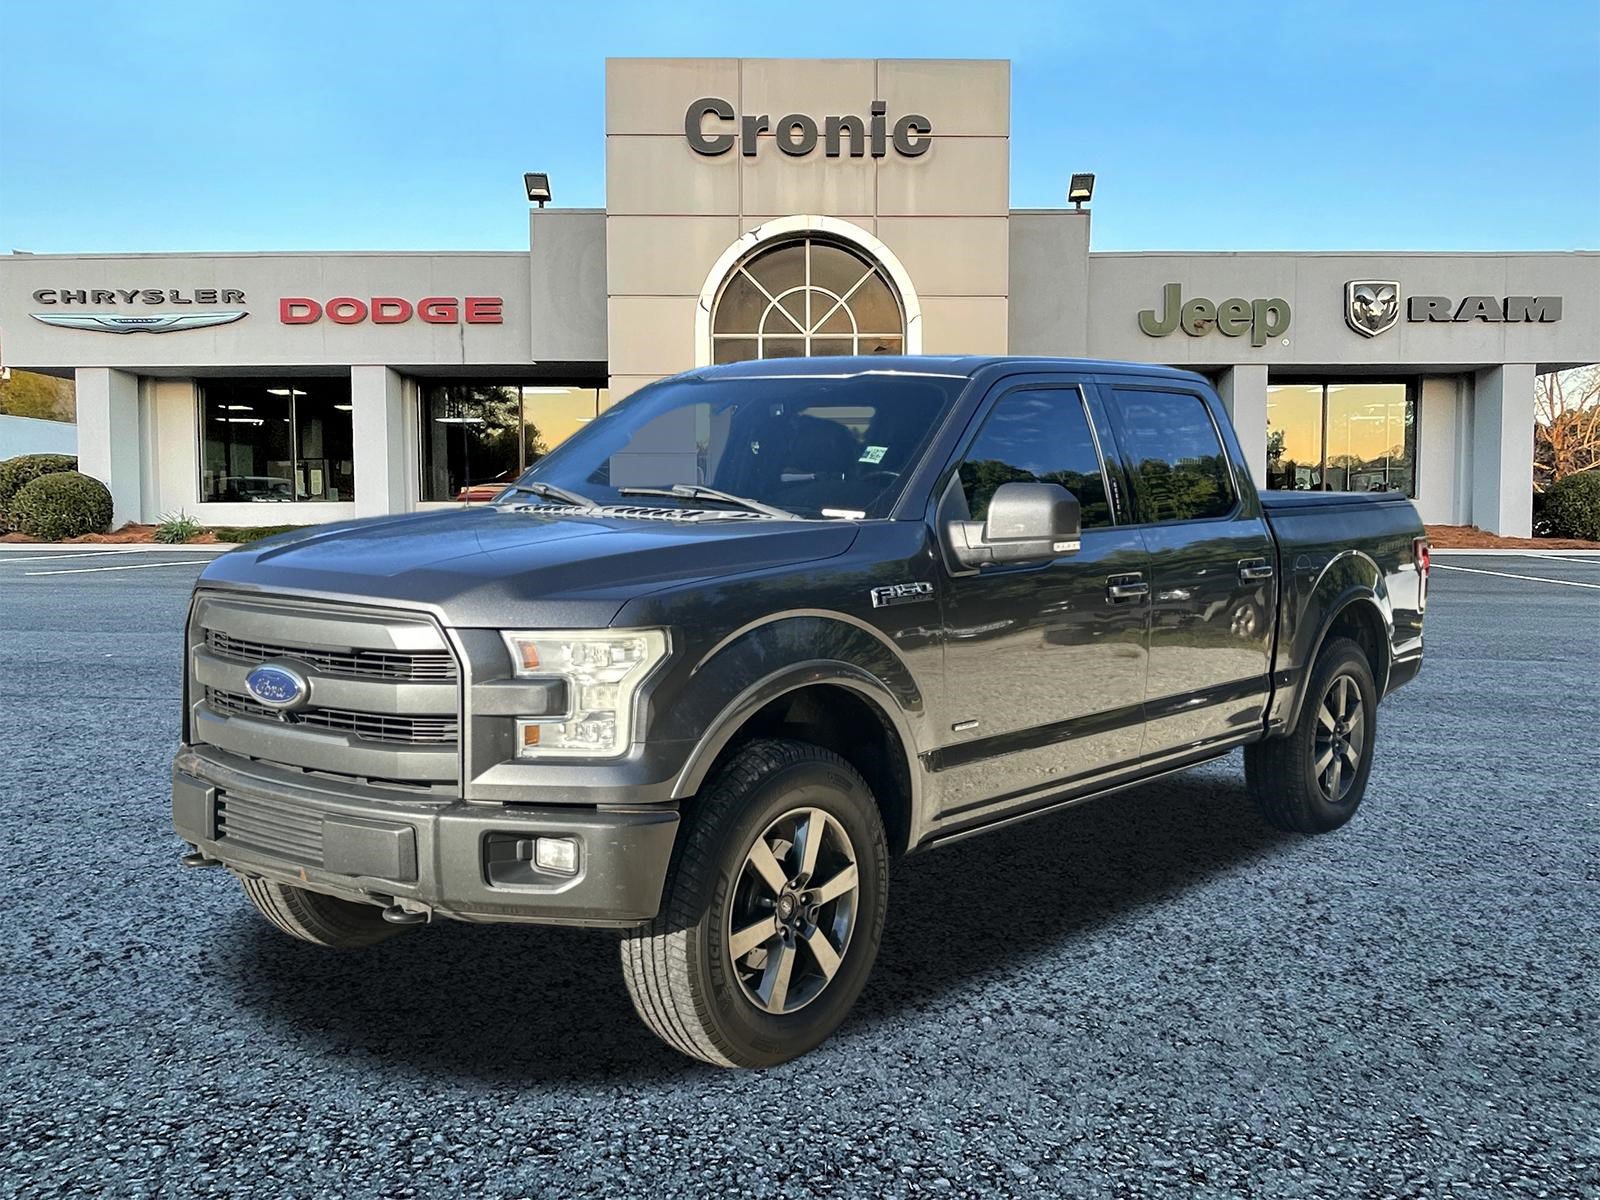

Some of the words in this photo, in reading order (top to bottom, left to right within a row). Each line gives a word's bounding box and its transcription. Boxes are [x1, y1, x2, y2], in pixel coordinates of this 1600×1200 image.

[684, 97, 932, 158] Cronic
[32, 289, 247, 305] CHRYSLER
[279, 296, 504, 325] DODGE
[1408, 295, 1563, 323] RAM
[1138, 283, 1291, 347] Jeep
[255, 677, 287, 698] Ford
